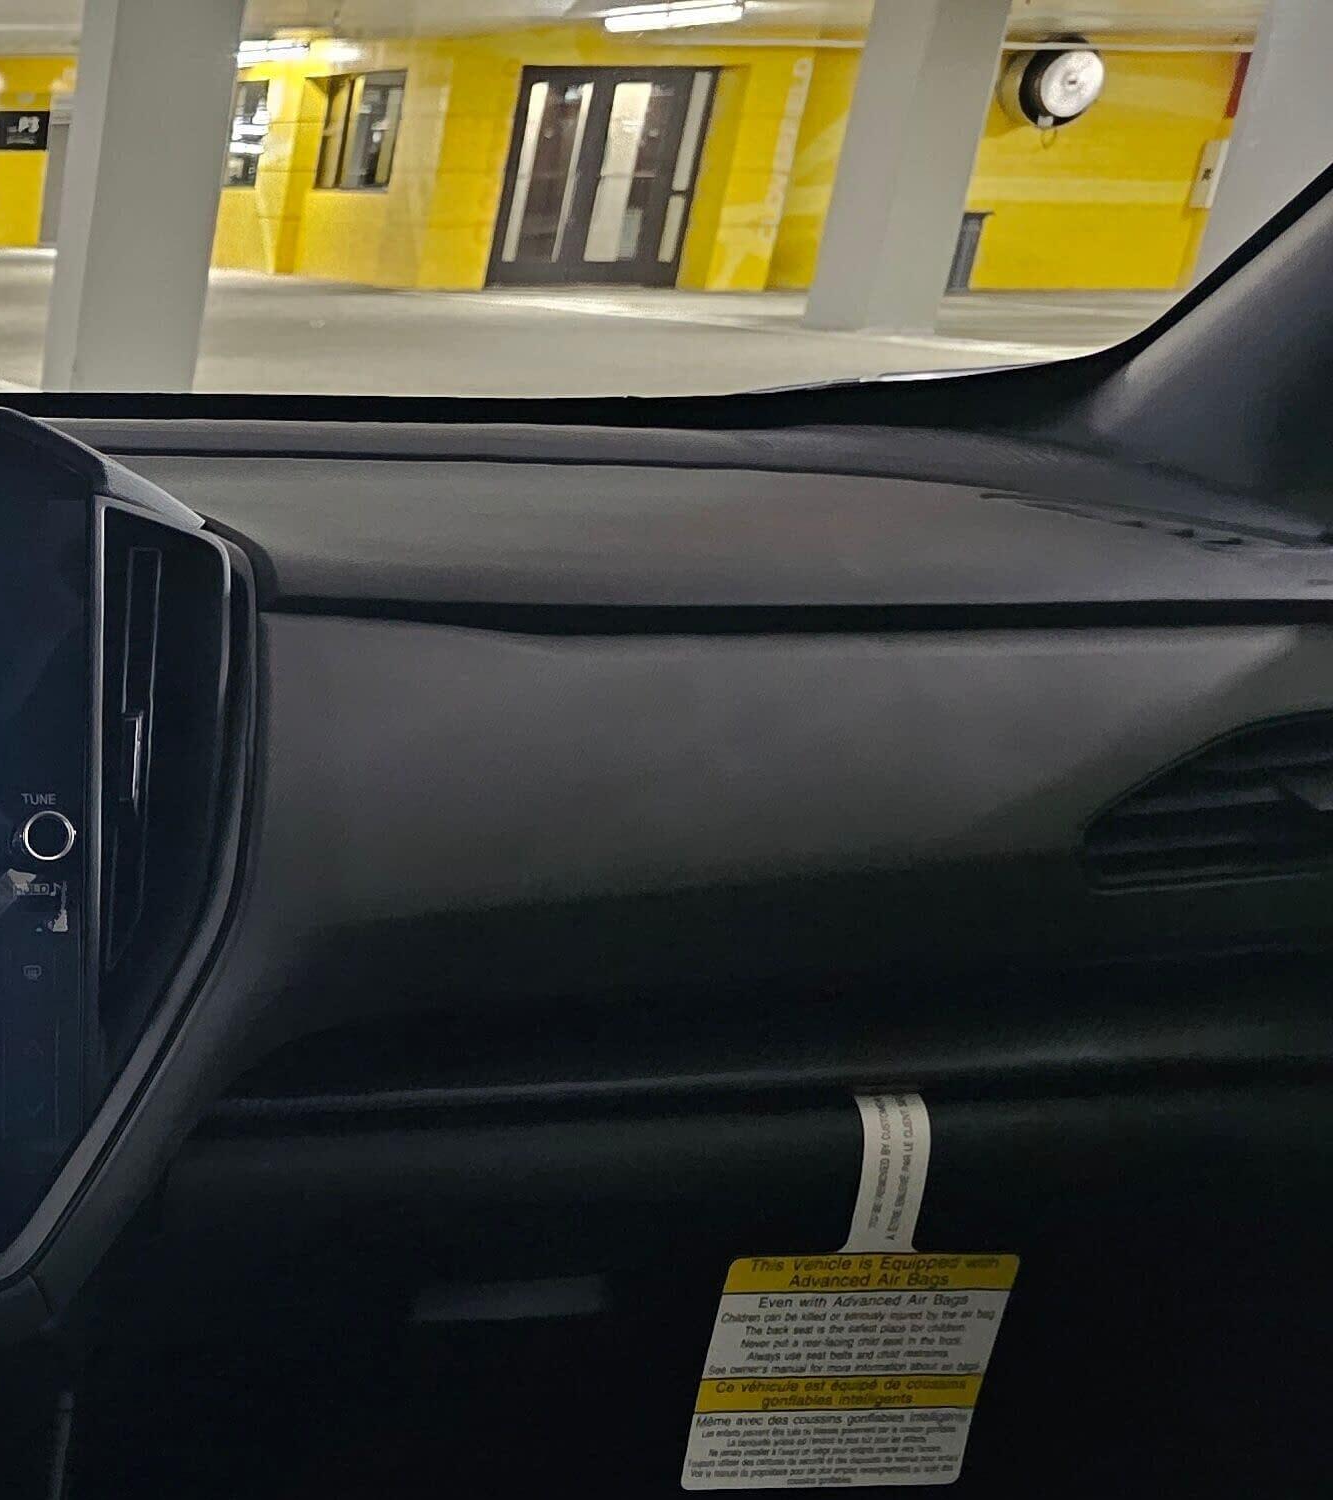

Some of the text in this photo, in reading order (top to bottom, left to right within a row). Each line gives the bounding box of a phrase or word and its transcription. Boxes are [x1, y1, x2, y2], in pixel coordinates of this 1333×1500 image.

[21, 793, 57, 805] TUNE
[751, 1258, 785, 1272] This
[793, 1258, 851, 1271] Vehicle
[859, 1258, 873, 1270] is
[880, 1257, 958, 1273] Equipped
[788, 1272, 949, 1288] Advanced Air Bags
[758, 1294, 969, 1309] Even with Advanced Air Bags
[716, 1381, 735, 1394] Ce
[804, 1379, 826, 1392] est
[884, 1379, 901, 1391] de
